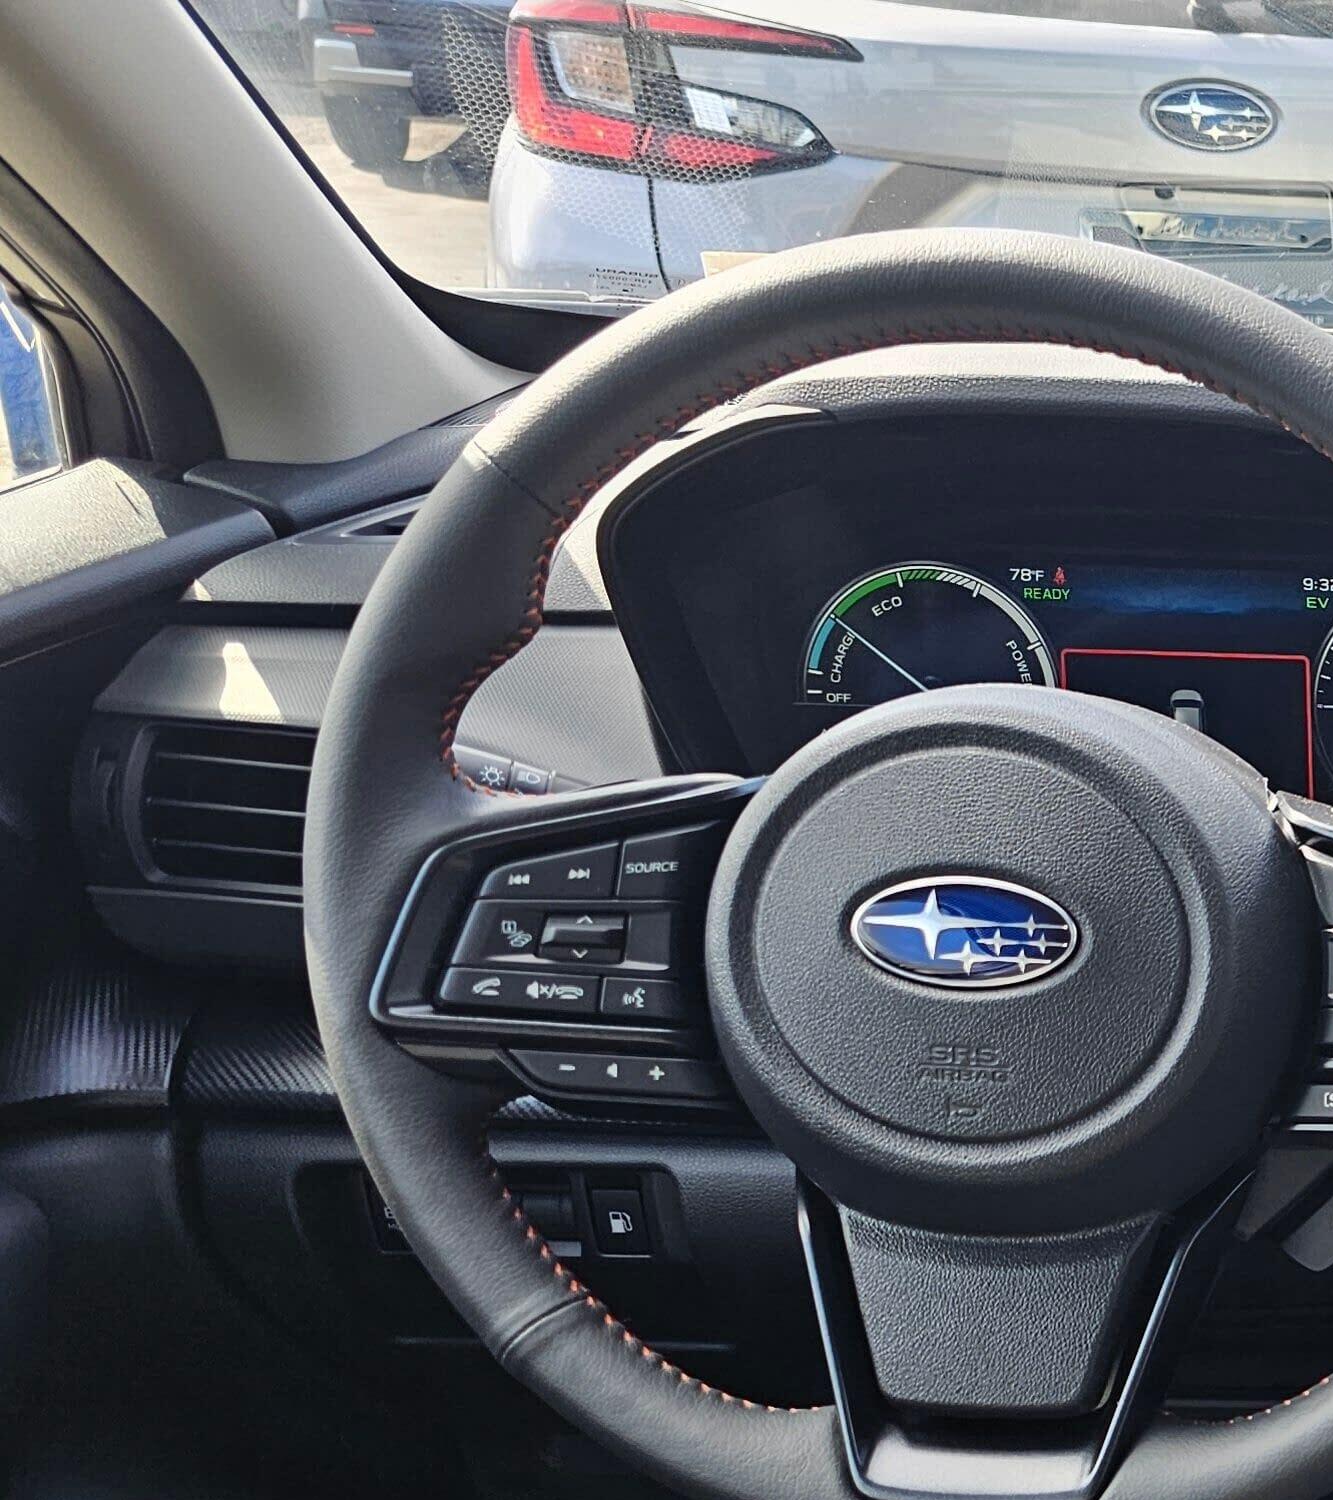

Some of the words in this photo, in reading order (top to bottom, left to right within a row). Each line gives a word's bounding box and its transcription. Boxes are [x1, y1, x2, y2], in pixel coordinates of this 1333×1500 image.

[1024, 587, 1070, 601] READY
[871, 596, 903, 617] ECO
[1306, 598, 1329, 609] EV
[1006, 640, 1032, 684] POWE
[826, 693, 852, 703] OFF
[625, 861, 679, 874] SOURCE
